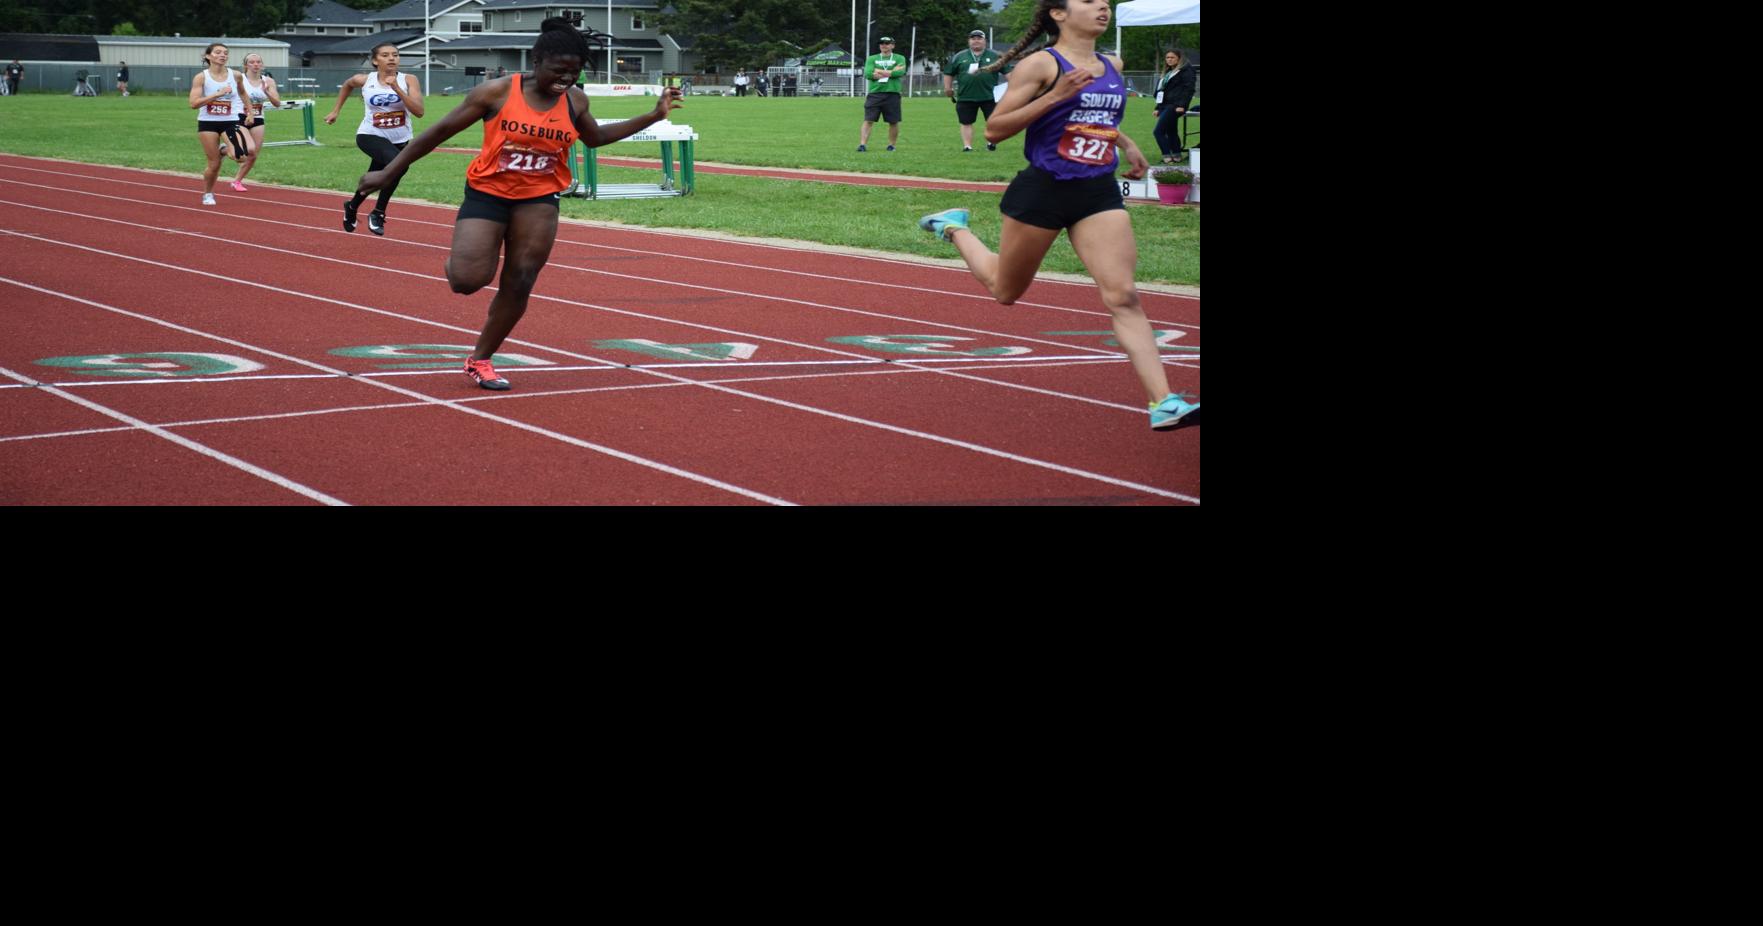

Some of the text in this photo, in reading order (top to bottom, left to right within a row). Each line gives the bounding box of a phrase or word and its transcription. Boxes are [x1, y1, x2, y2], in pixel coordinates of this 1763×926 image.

[1080, 93, 1122, 109] SOUTH
[501, 119, 573, 143] ROSEBURG
[507, 152, 550, 171] 218
[1122, 181, 1130, 196] 8
